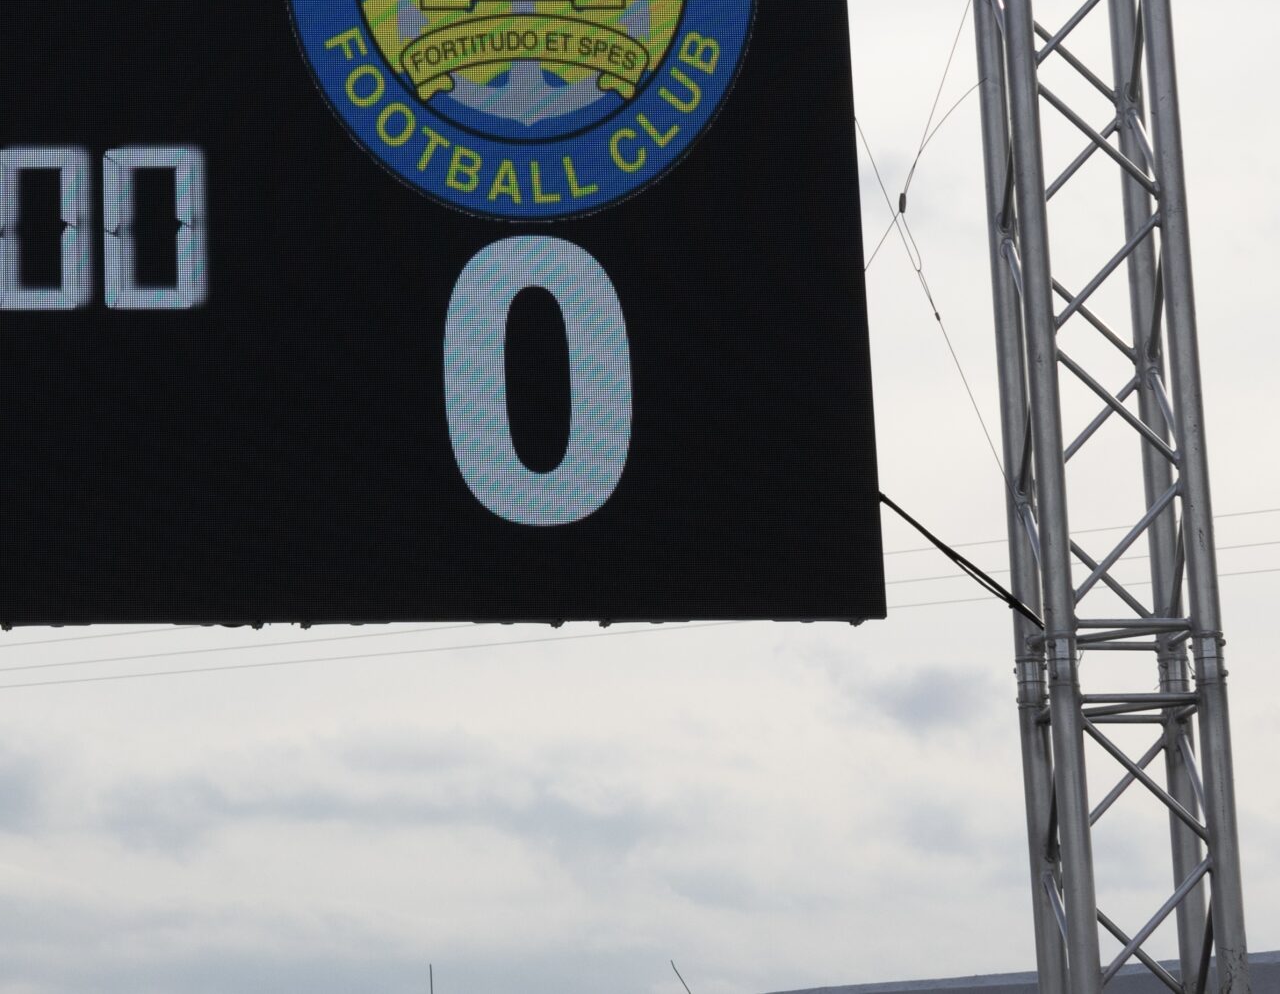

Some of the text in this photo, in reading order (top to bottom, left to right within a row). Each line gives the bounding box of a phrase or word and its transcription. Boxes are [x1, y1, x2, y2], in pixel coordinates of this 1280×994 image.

[325, 27, 721, 204] FOOTBALL CLUB
[412, 30, 638, 72] FORTITUDO ET SPES
[442, 235, 632, 527] 0
